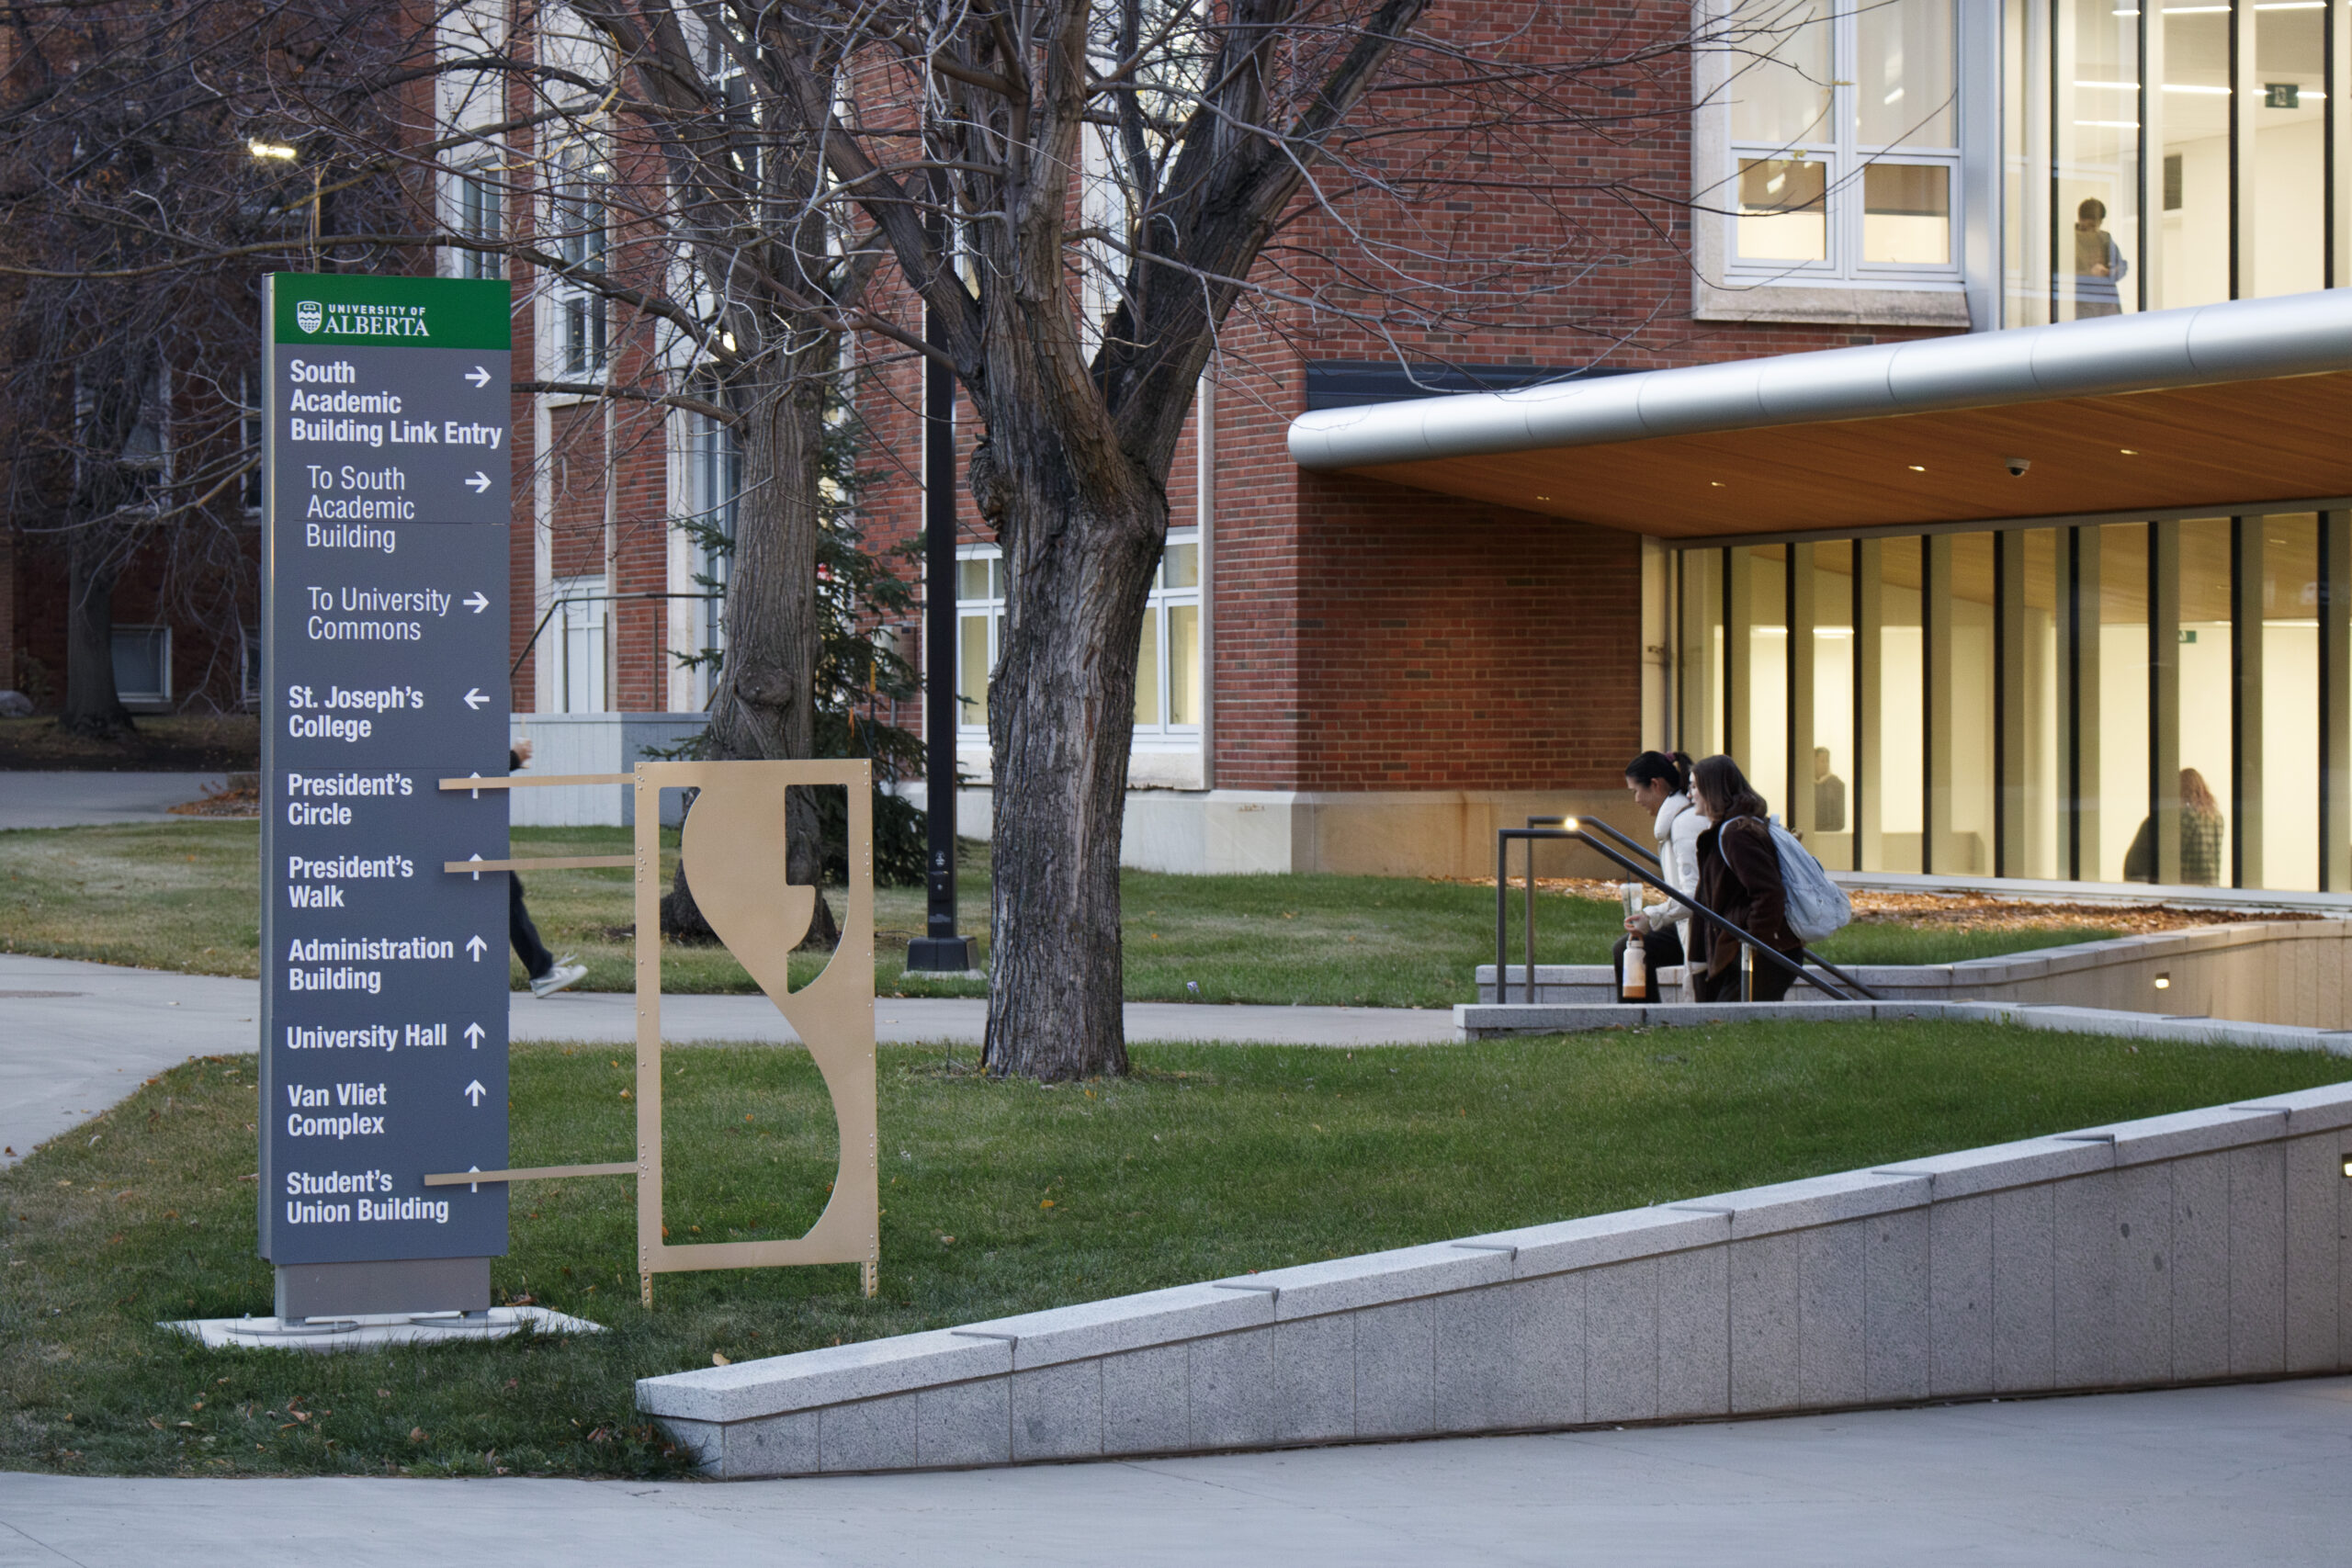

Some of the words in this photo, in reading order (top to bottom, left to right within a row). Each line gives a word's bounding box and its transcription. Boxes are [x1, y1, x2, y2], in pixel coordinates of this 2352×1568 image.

[328, 303, 406, 315] UNIVERSITY
[410, 306, 426, 316] OF
[322, 315, 430, 336] ALBERTA
[290, 359, 356, 383] South
[289, 389, 402, 413] Academic
[291, 417, 383, 447] Building
[390, 420, 438, 443] Link
[445, 421, 503, 449] Entry
[306, 465, 334, 489] To
[341, 465, 405, 490] South
[307, 494, 415, 519] Academic
[306, 523, 396, 553] Building
[307, 586, 334, 610] To
[342, 587, 451, 616] University
[308, 615, 422, 640] Commons
[288, 684, 319, 708] St.
[288, 714, 372, 742] College
[288, 802, 352, 825] Circle
[288, 885, 345, 908] Walk
[288, 936, 454, 961] Administration
[289, 966, 381, 994] Building
[287, 1024, 399, 1051] University
[405, 1023, 447, 1045] Hall
[287, 1084, 330, 1107] Van
[335, 1082, 387, 1105] Vliet
[288, 1111, 385, 1139] Complex
[287, 1200, 351, 1224] Union
[357, 1196, 449, 1224] Building
